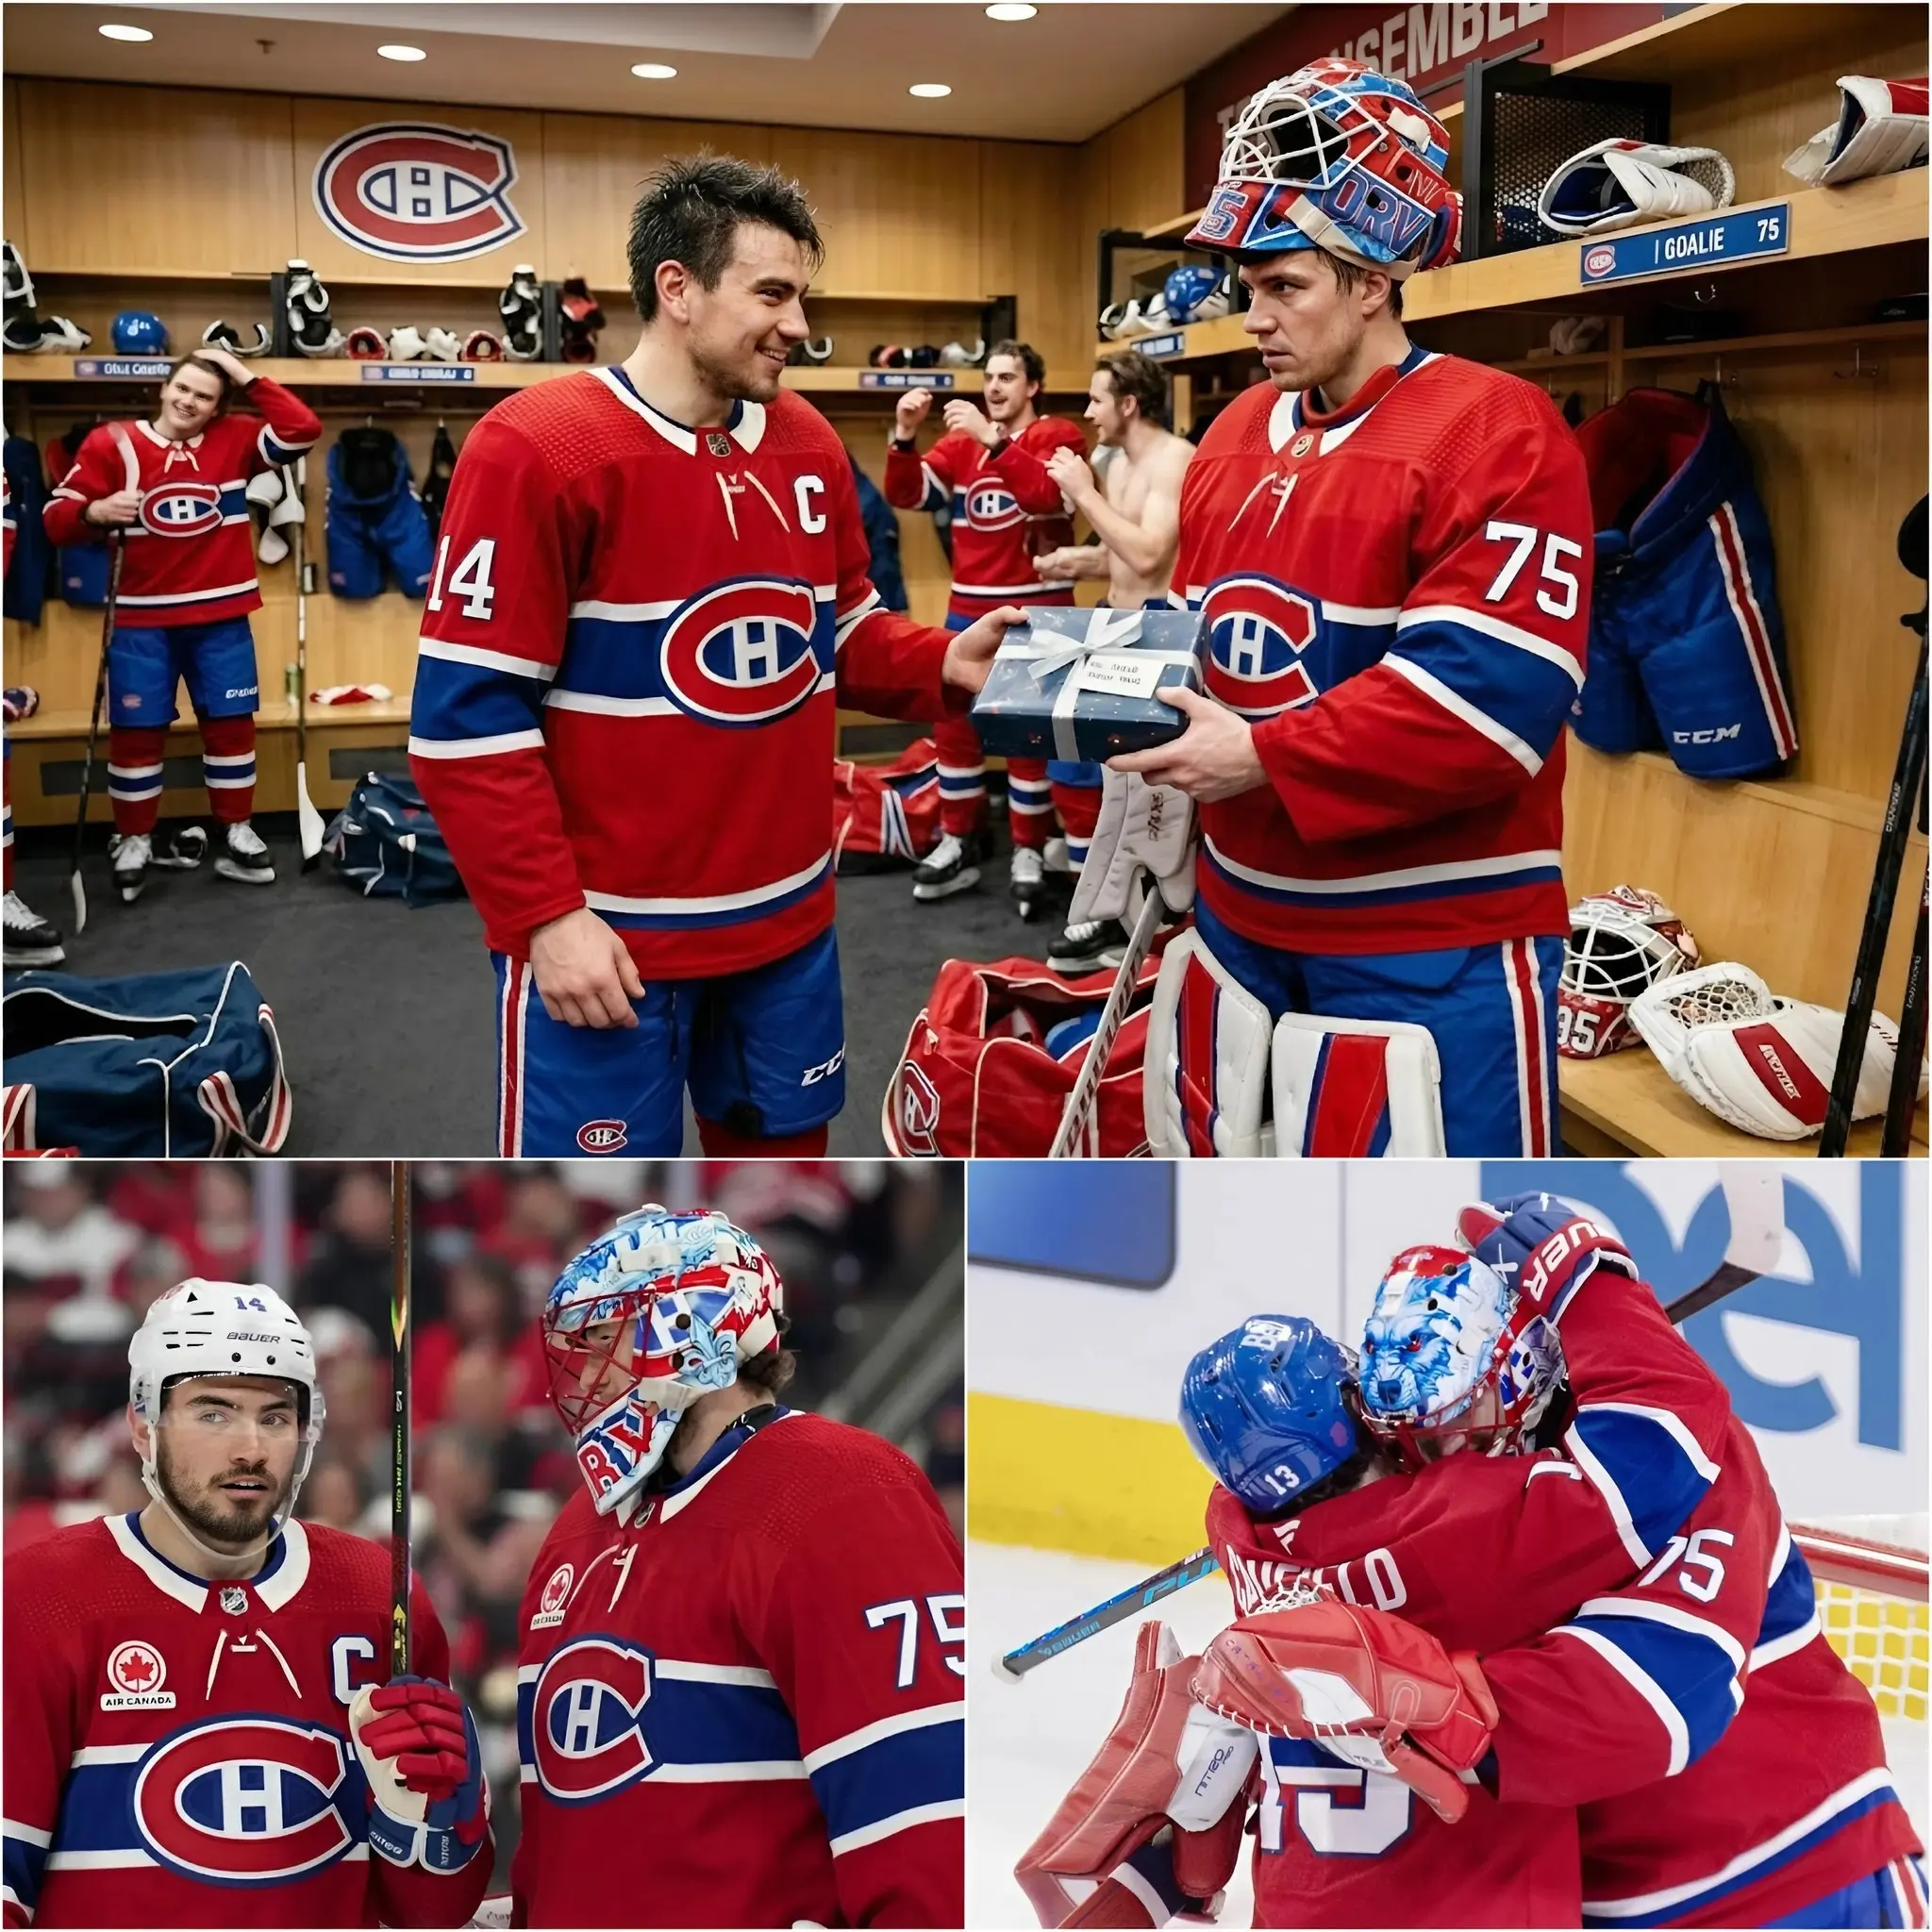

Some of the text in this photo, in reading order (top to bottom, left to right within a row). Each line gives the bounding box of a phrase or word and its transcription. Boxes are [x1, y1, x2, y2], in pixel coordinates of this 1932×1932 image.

[1664, 227, 1724, 260] GOALIE
[1757, 217, 1780, 242] 75
[793, 475, 826, 534] C
[427, 535, 497, 621] 14
[1484, 520, 1584, 622] 75
[1673, 723, 1741, 744] CCM
[234, 1296, 268, 1312] 14
[226, 1331, 281, 1344] BAUER
[1265, 1465, 1300, 1495] 13
[864, 1593, 965, 1689] 75
[332, 1637, 375, 1705] C
[106, 1696, 172, 1707] AIR CANADA
